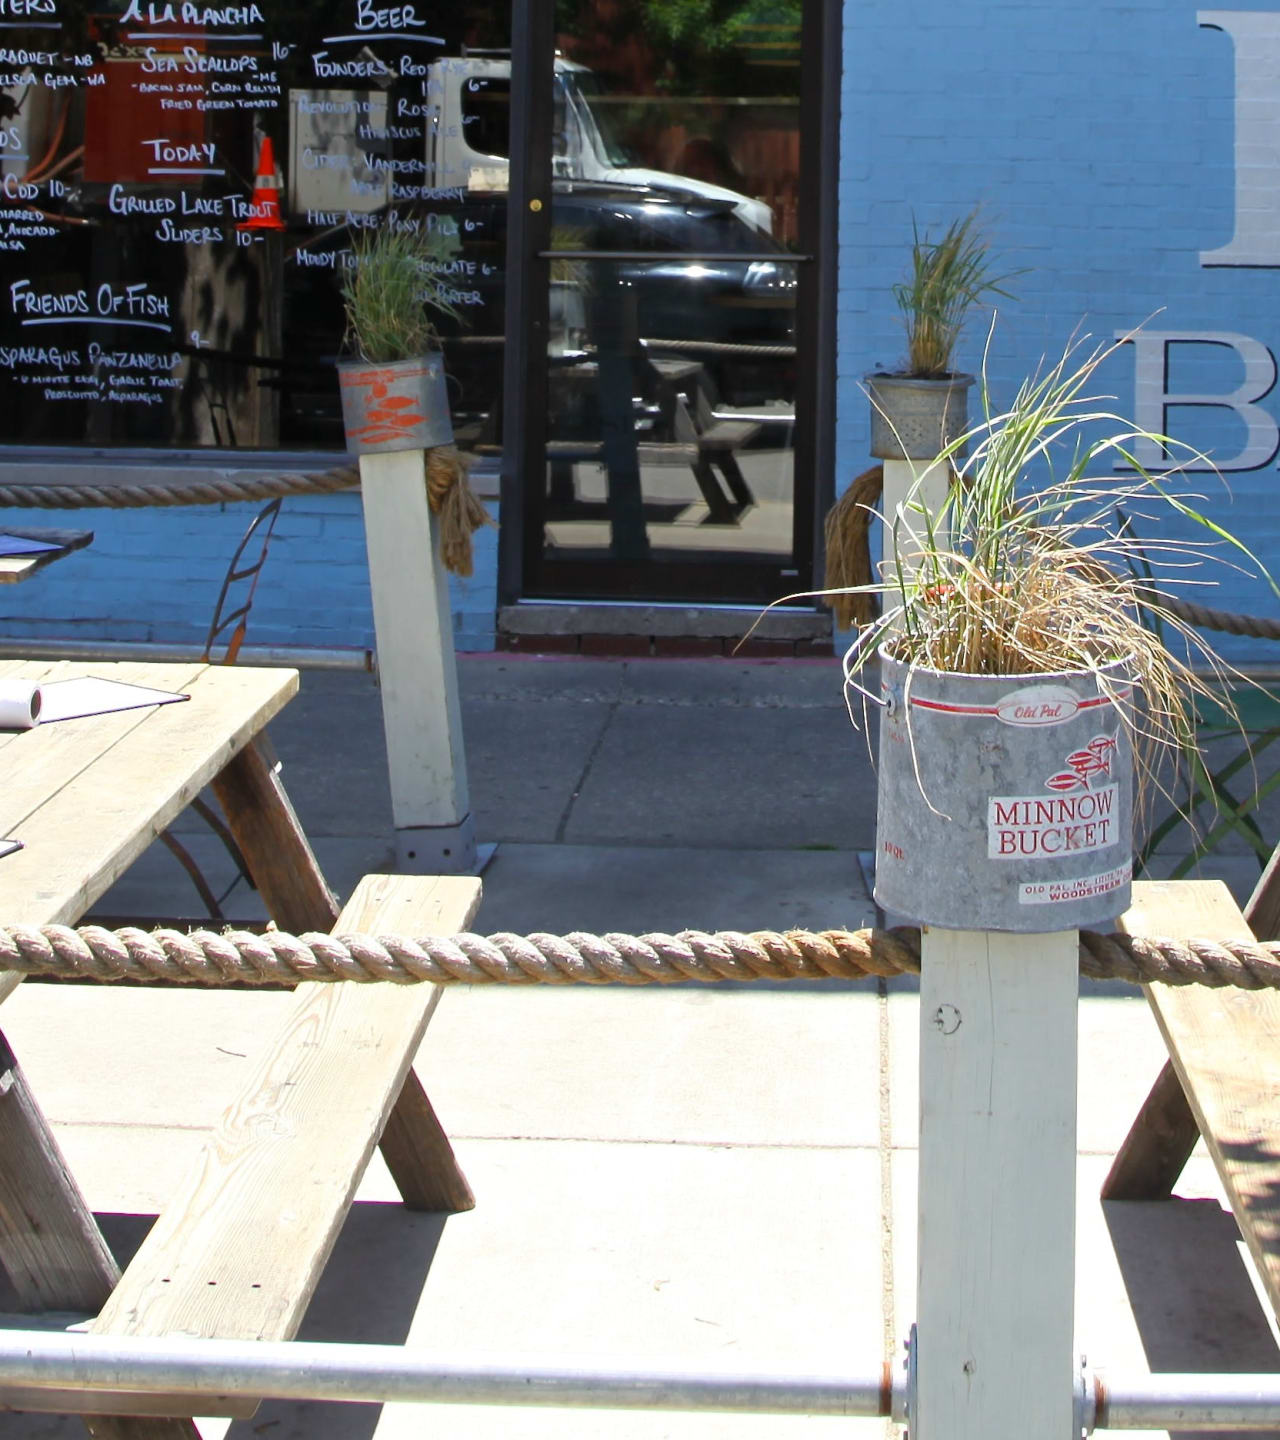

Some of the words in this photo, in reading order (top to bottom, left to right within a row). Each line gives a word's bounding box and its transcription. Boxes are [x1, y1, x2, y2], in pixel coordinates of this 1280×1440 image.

[149, 3, 177, 25] LA
[181, 2, 266, 25] PLANCHA
[141, 47, 179, 73] SEA
[183, 46, 258, 74] SCALLOPS
[141, 139, 216, 164] TODAY
[4, 172, 39, 199] COD
[109, 183, 176, 216] GRILLED
[180, 191, 224, 215] LAKE
[223, 194, 277, 218] TROUT
[156, 218, 223, 244] SLIDERS
[10, 279, 89, 314] FRIENDS
[97, 283, 124, 315] OF
[125, 283, 170, 317] FISH
[1015, 705, 1037, 718] Old
[1040, 703, 1062, 718] Pal
[994, 789, 1114, 826] MINNOW
[998, 819, 1110, 855] BUCKET
[1025, 886, 1045, 895] OLD
[1049, 879, 1121, 901] WOODSTREAM
